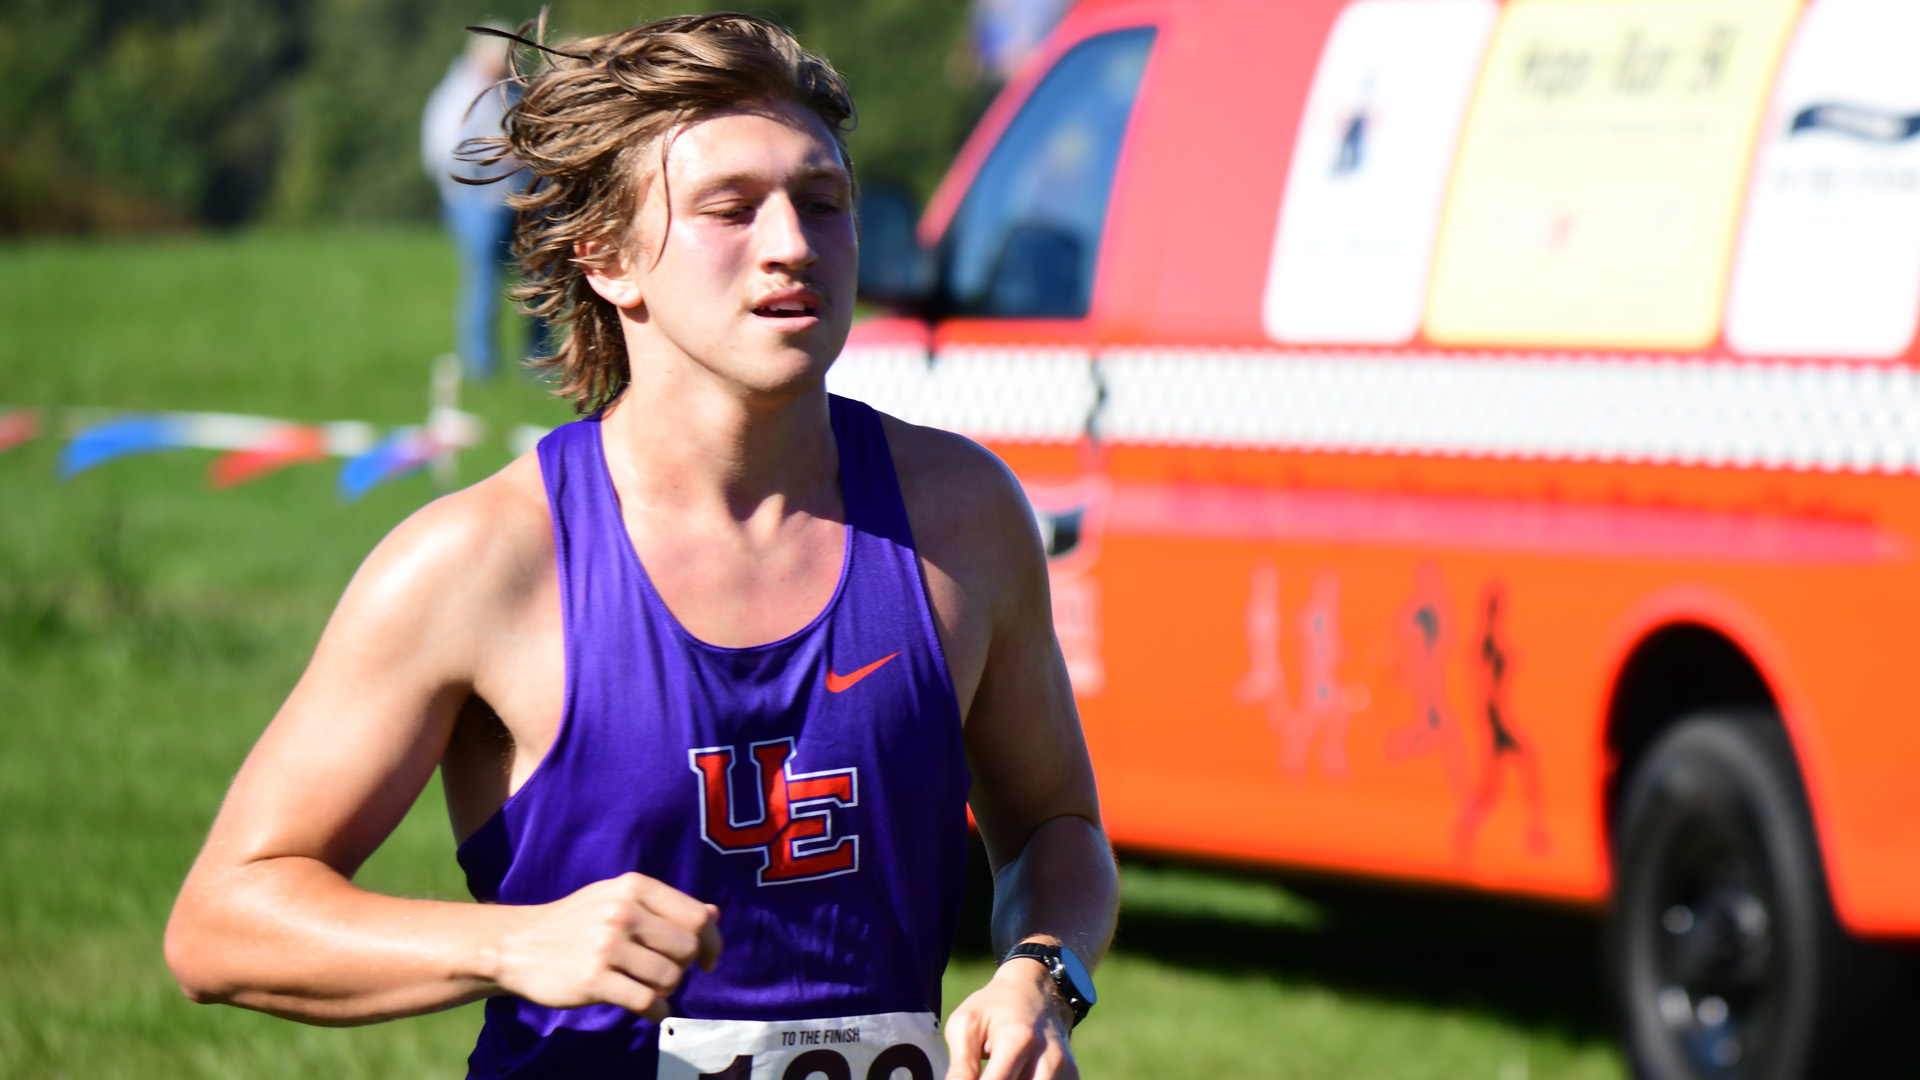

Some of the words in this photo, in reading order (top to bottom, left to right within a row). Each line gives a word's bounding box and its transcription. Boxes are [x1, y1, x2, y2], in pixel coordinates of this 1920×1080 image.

[689, 736, 859, 887] UE
[782, 1031, 796, 1046] TO
[800, 1029, 821, 1045] THE
[823, 1026, 861, 1044] FINISH
